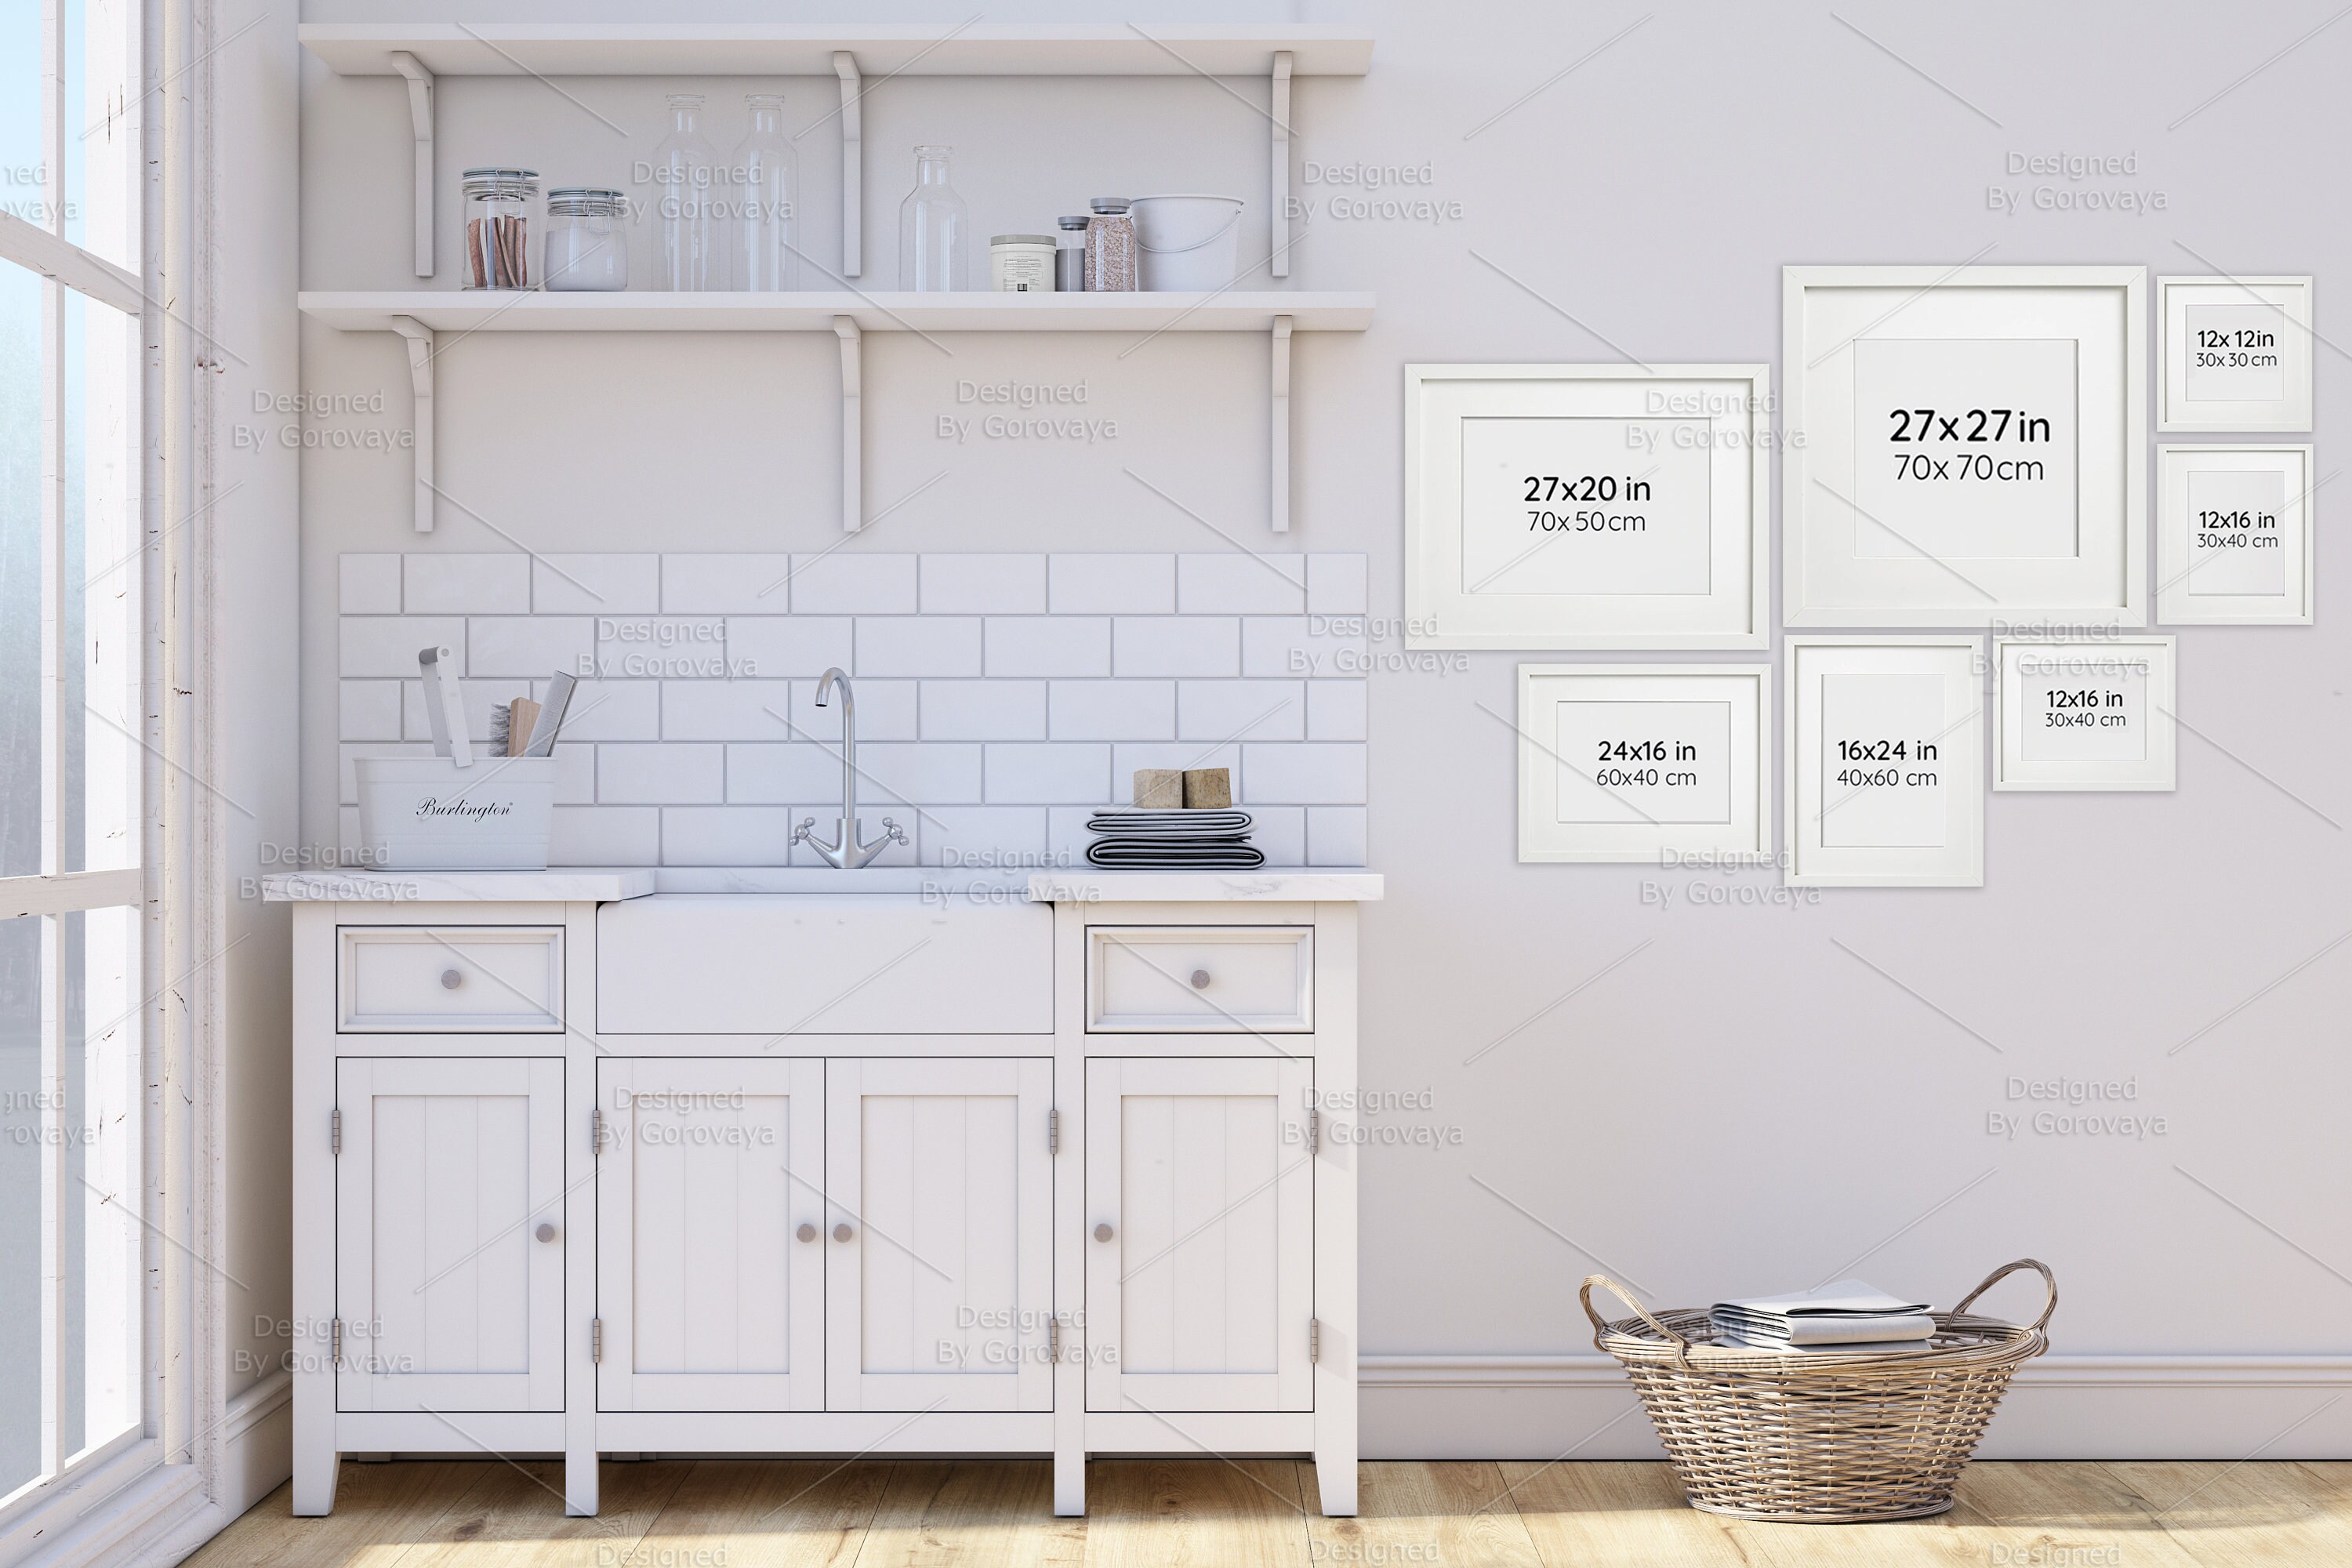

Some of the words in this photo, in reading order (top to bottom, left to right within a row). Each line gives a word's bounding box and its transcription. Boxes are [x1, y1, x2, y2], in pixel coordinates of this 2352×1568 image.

[1523, 475, 1617, 502] 27x20
[1626, 476, 1651, 502] in
[2198, 510, 2251, 529] 12x16
[2258, 511, 2275, 529] in
[2198, 533, 2248, 548] 30x40
[2252, 536, 2278, 548] cm
[2046, 689, 2099, 708] 12x16
[2106, 690, 2123, 708] in
[2045, 712, 2095, 728] 30x40
[2100, 715, 2126, 727] cm
[1598, 740, 1667, 761] 24x16
[1675, 740, 1697, 761] in
[1838, 739, 1907, 761] 16x24
[1917, 739, 1937, 761] in
[1596, 768, 1659, 786] 60x40
[1665, 772, 1697, 786] cm
[1836, 768, 1900, 787] 40x60
[1906, 772, 1937, 787] cm
[416, 797, 512, 822] Burlington
